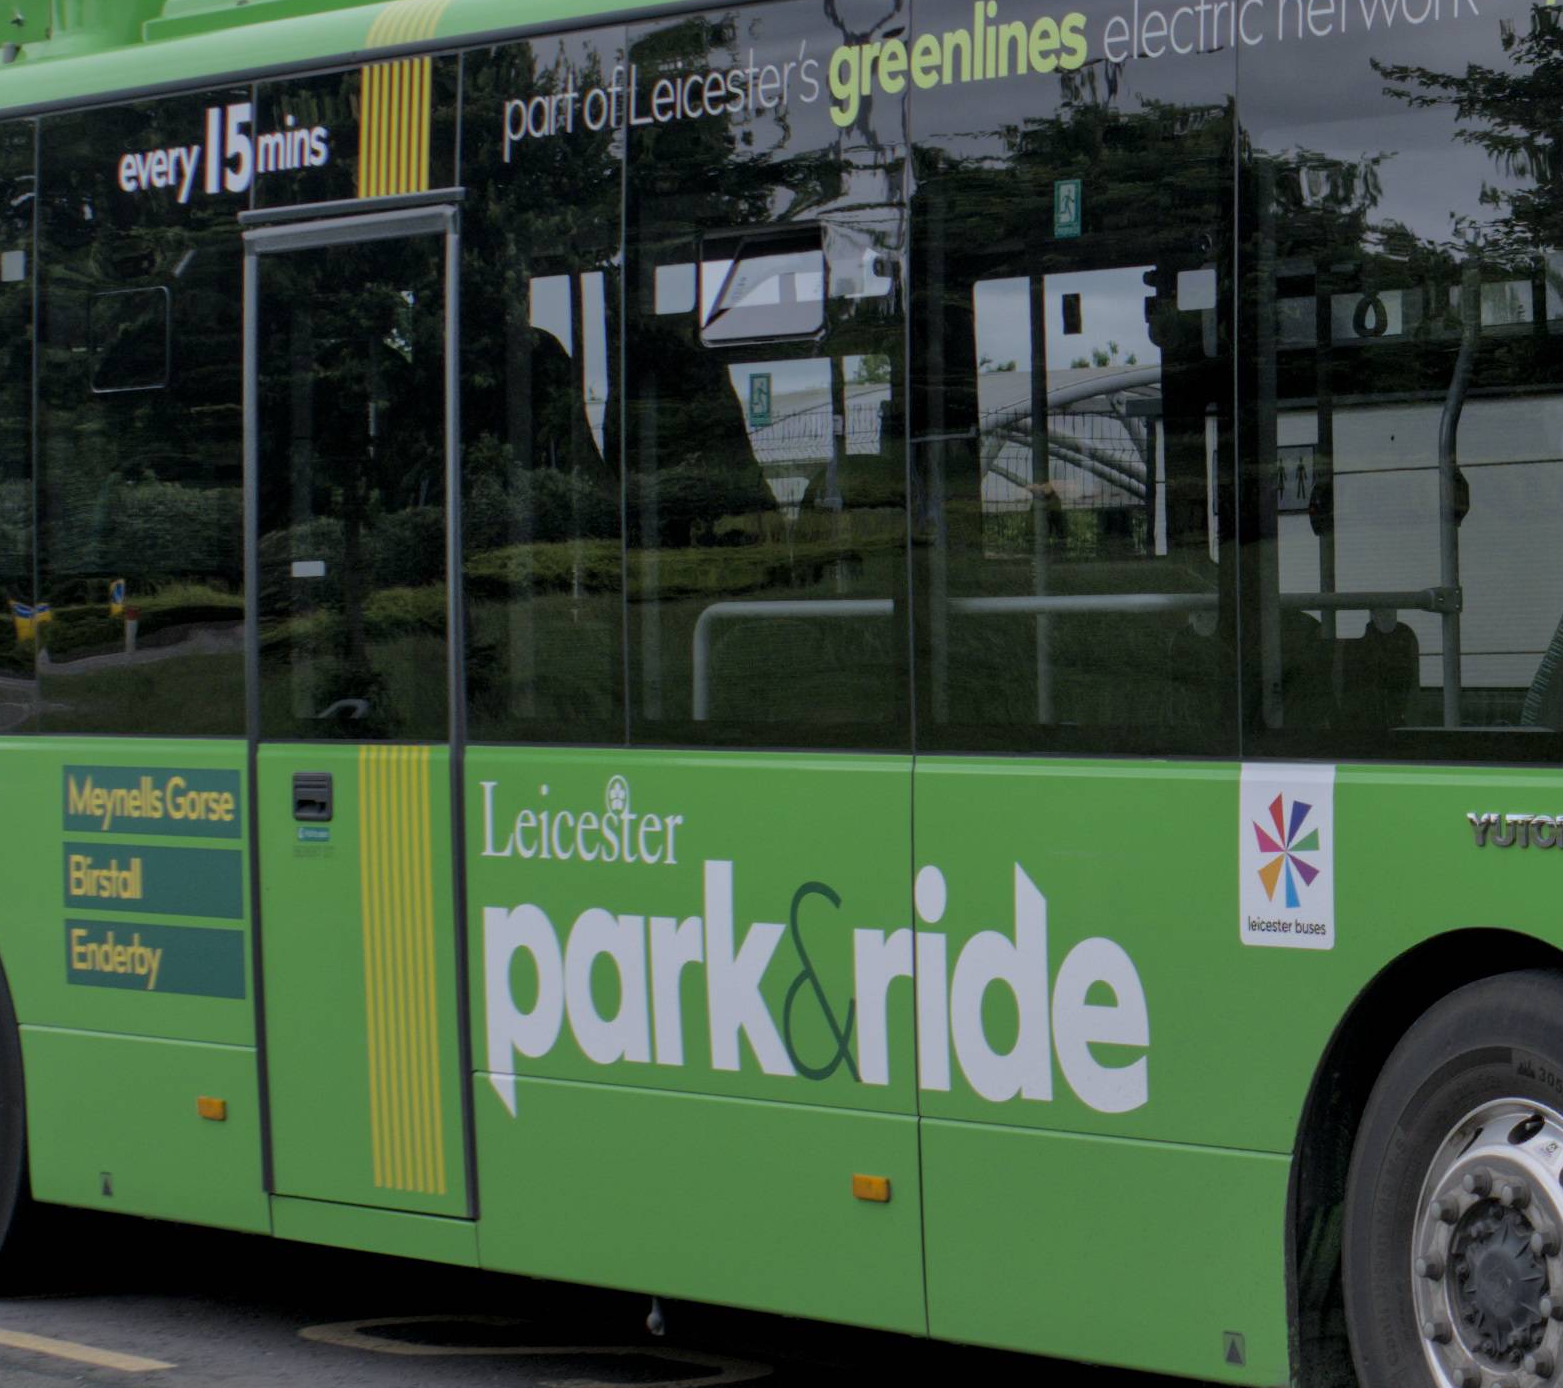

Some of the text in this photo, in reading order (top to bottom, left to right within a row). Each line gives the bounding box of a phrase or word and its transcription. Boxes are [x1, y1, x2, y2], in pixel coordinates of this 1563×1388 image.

[503, 87, 577, 163] part
[584, 63, 626, 130] of
[628, 40, 820, 127] Leicester's
[828, 0, 1089, 127] greenlines
[118, 102, 329, 204] every 15 mins
[67, 774, 235, 832] Meynells Gorse
[480, 776, 684, 866] Leicester
[68, 853, 143, 901] Birstall
[1248, 915, 1327, 936] leicester buses
[70, 937, 164, 991] Enderby
